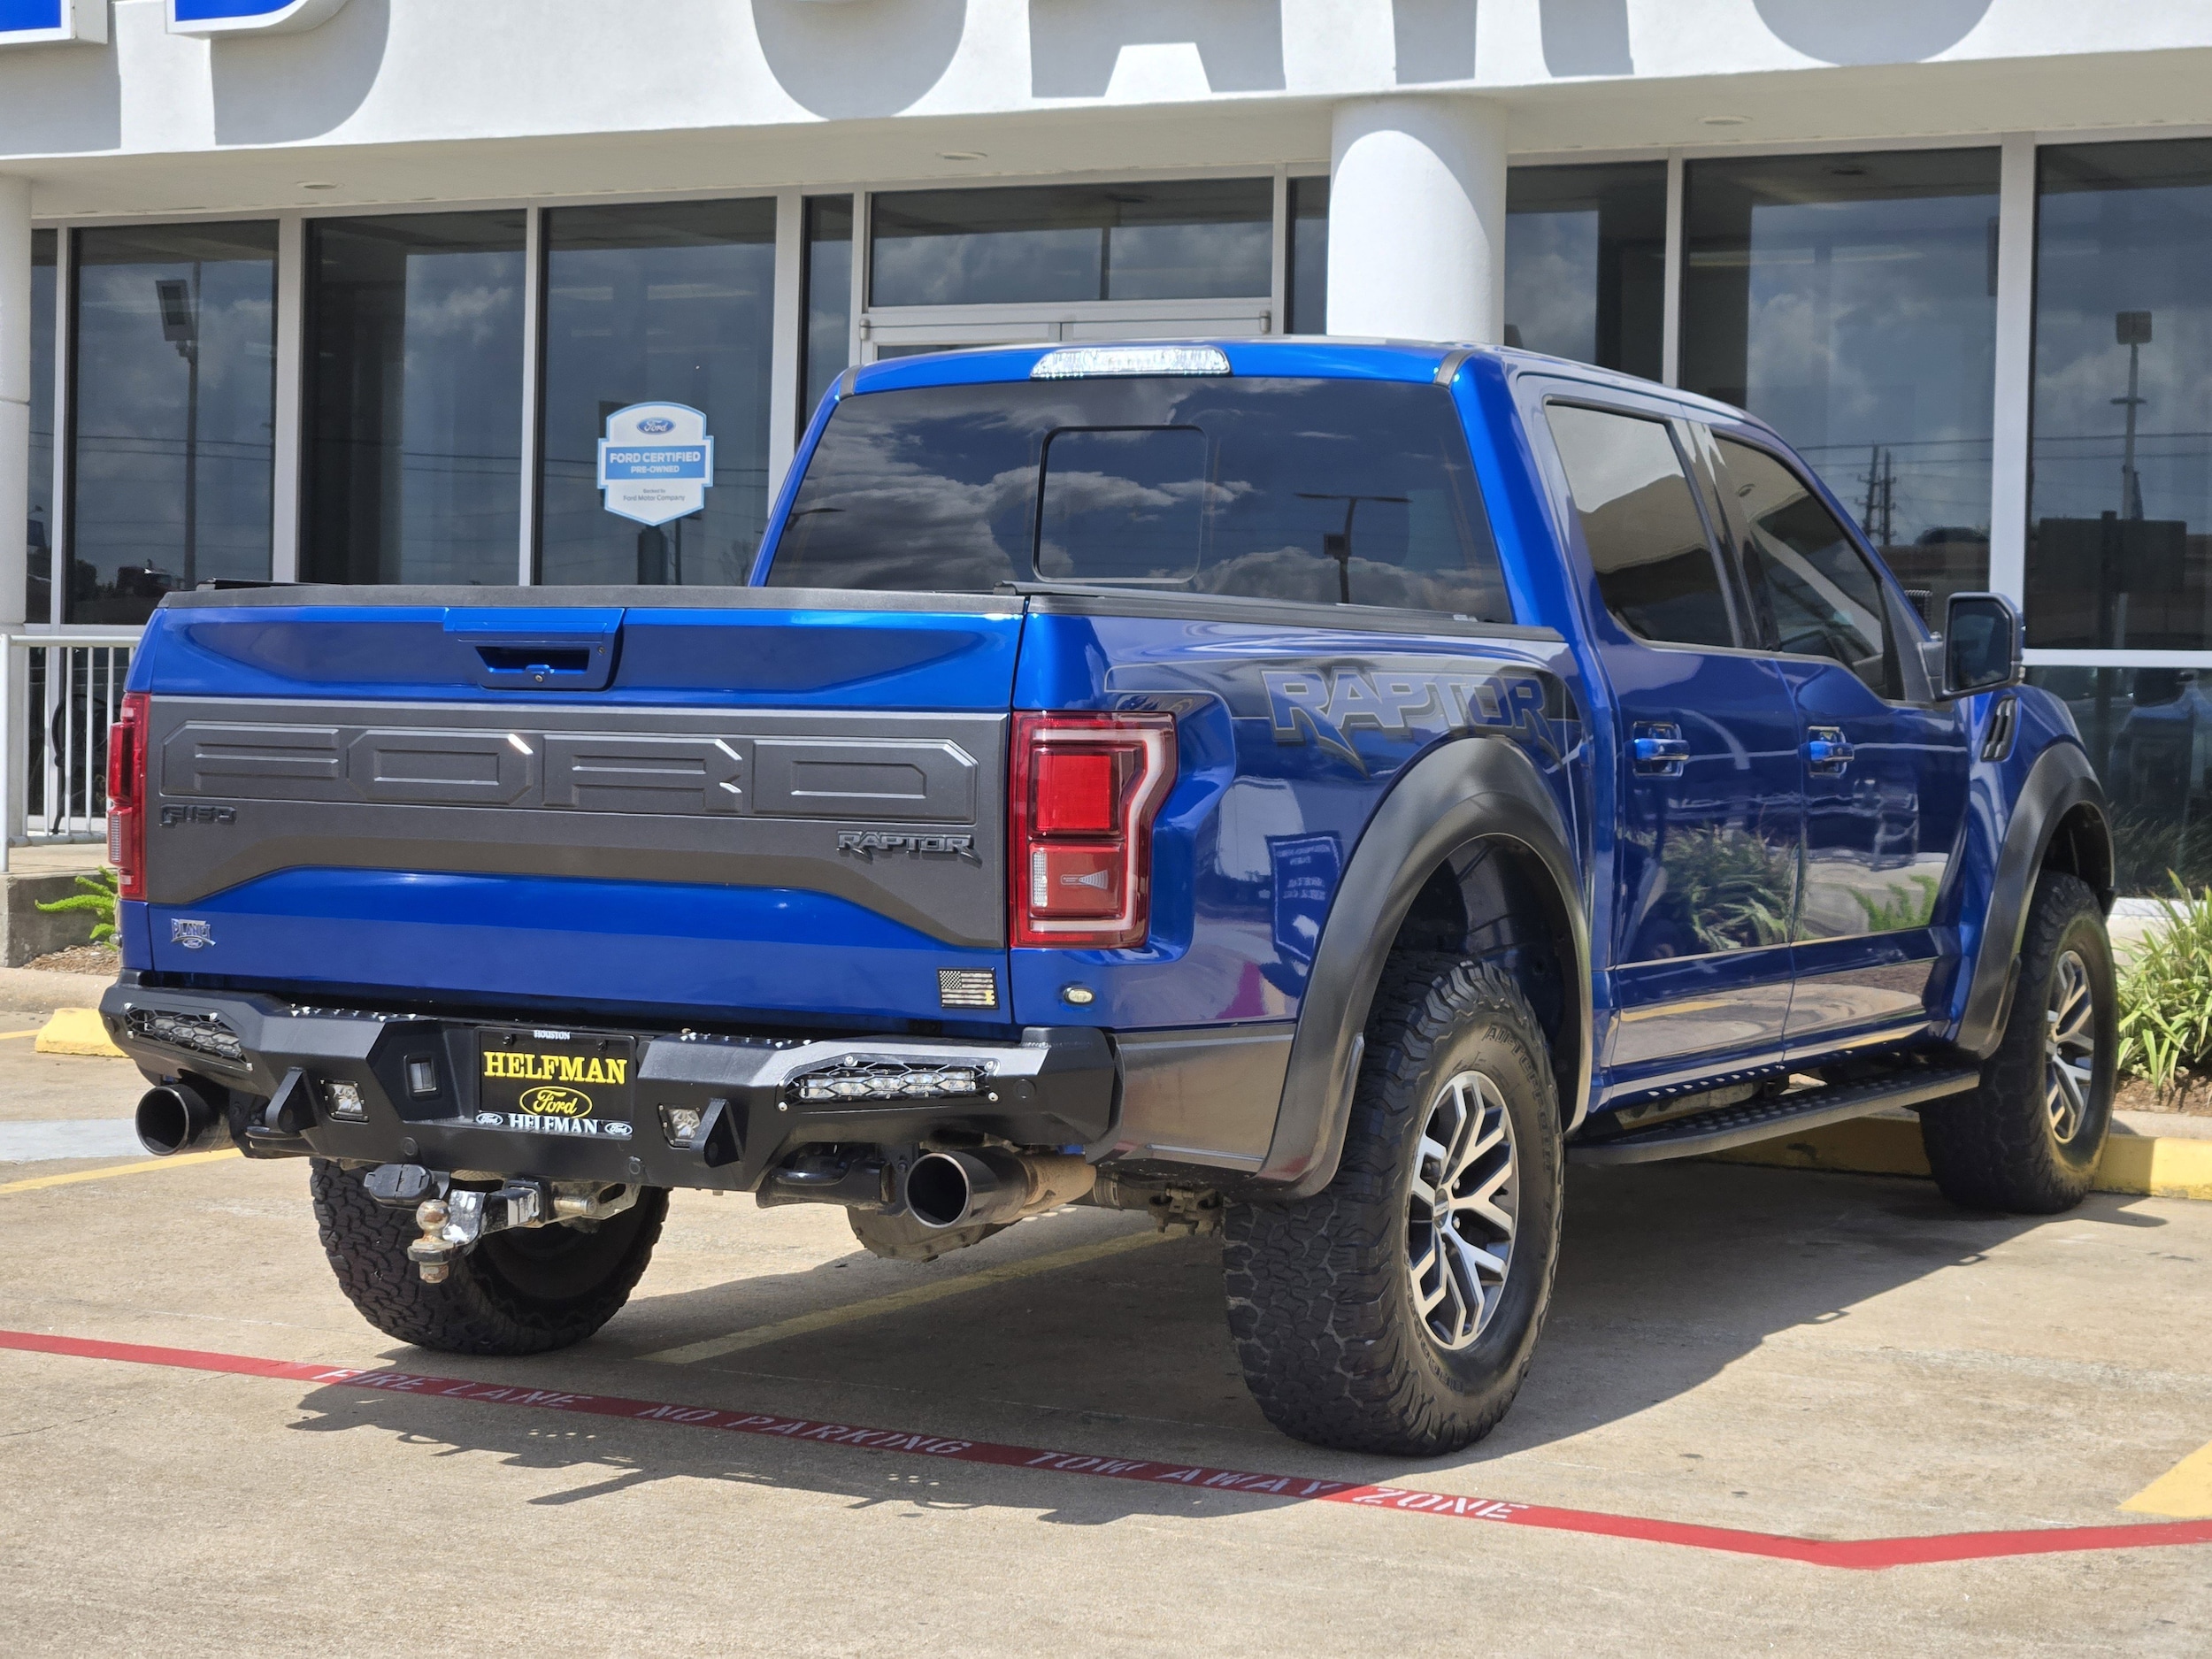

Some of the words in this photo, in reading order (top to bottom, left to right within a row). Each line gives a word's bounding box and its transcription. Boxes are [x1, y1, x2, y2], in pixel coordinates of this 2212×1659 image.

[643, 419, 668, 432] Ford
[610, 453, 641, 464] FORD
[642, 451, 701, 463] CERTIFIED
[657, 494, 686, 503] Company
[1260, 666, 1565, 779] RAPTOR
[160, 721, 979, 826] FORD
[836, 829, 982, 865] RAPTOR
[534, 1030, 571, 1040] HOUSTON
[483, 1051, 628, 1085] HELFMAN
[533, 1089, 579, 1115] Ford
[508, 1113, 600, 1134] HELFMAN
[312, 1369, 433, 1391] FIRE
[442, 1381, 595, 1409] LANE
[635, 1404, 718, 1424] NO
[726, 1416, 972, 1455] PARKING
[1025, 1451, 1150, 1474] TOW
[1156, 1468, 1342, 1495] AWAY
[1352, 1486, 1530, 1520] ZONE
